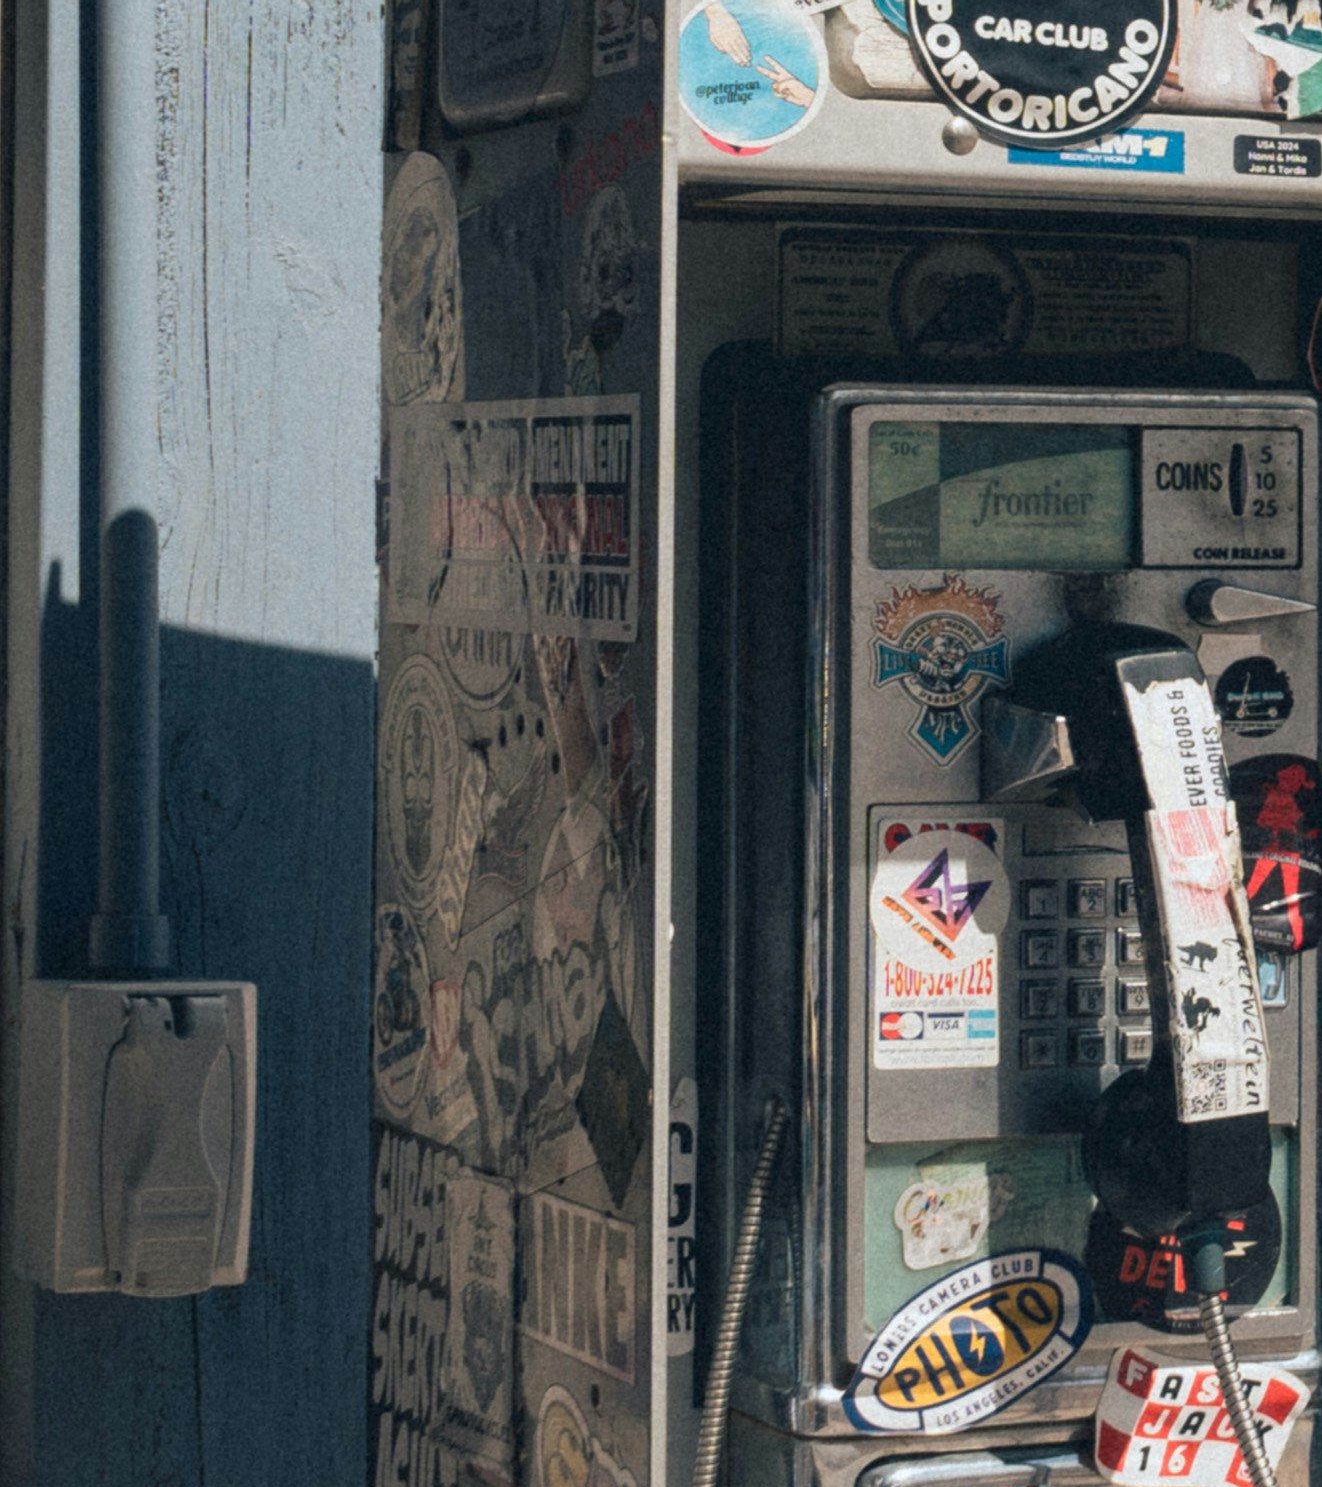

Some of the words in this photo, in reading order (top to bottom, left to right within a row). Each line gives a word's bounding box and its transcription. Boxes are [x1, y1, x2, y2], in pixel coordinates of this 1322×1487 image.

[974, 16, 1032, 45] CAR
[1037, 23, 1108, 51] CLUB
[1260, 445, 1272, 465] 5
[1156, 463, 1222, 492] COINS
[1255, 472, 1276, 490] 10
[973, 477, 1095, 527] frontier
[1253, 498, 1278, 517] 25
[1193, 546, 1228, 560] COIN
[1232, 546, 1287, 561] RELEASE
[1173, 702, 1200, 762] FOODS
[932, 1019, 960, 1031] VISA
[868, 1313, 917, 1373] LONERS
[918, 1271, 985, 1321] CAMERA
[989, 1255, 1036, 1281] CLUB
[897, 1288, 1055, 1403] PHOTO
[933, 1409, 964, 1430] LOS
[1025, 1346, 1068, 1379] CALIF.
